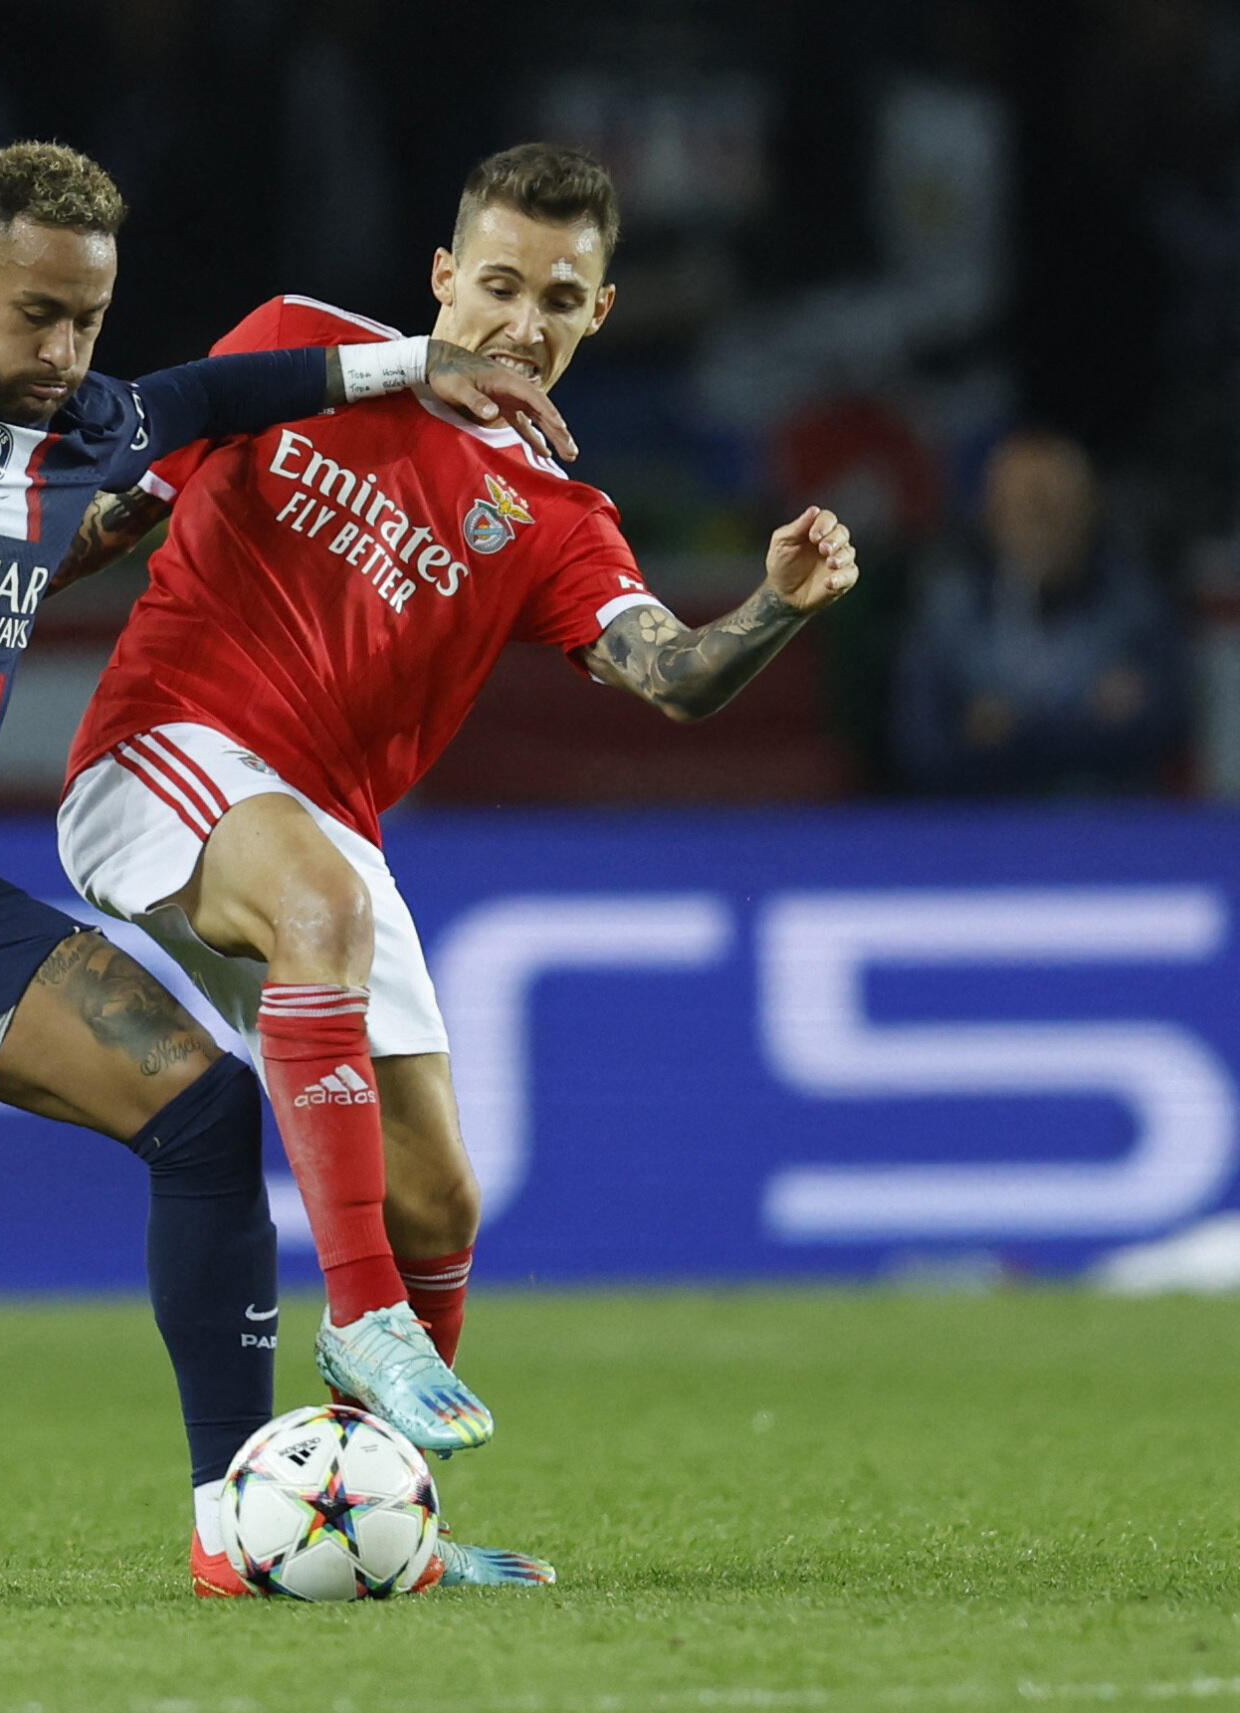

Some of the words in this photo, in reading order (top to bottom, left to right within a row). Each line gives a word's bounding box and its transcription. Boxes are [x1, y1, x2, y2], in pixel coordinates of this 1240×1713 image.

[268, 428, 470, 598] Emirates
[275, 490, 338, 538] FLY
[327, 523, 419, 615] BETTER
[293, 1086, 377, 1110] adidas
